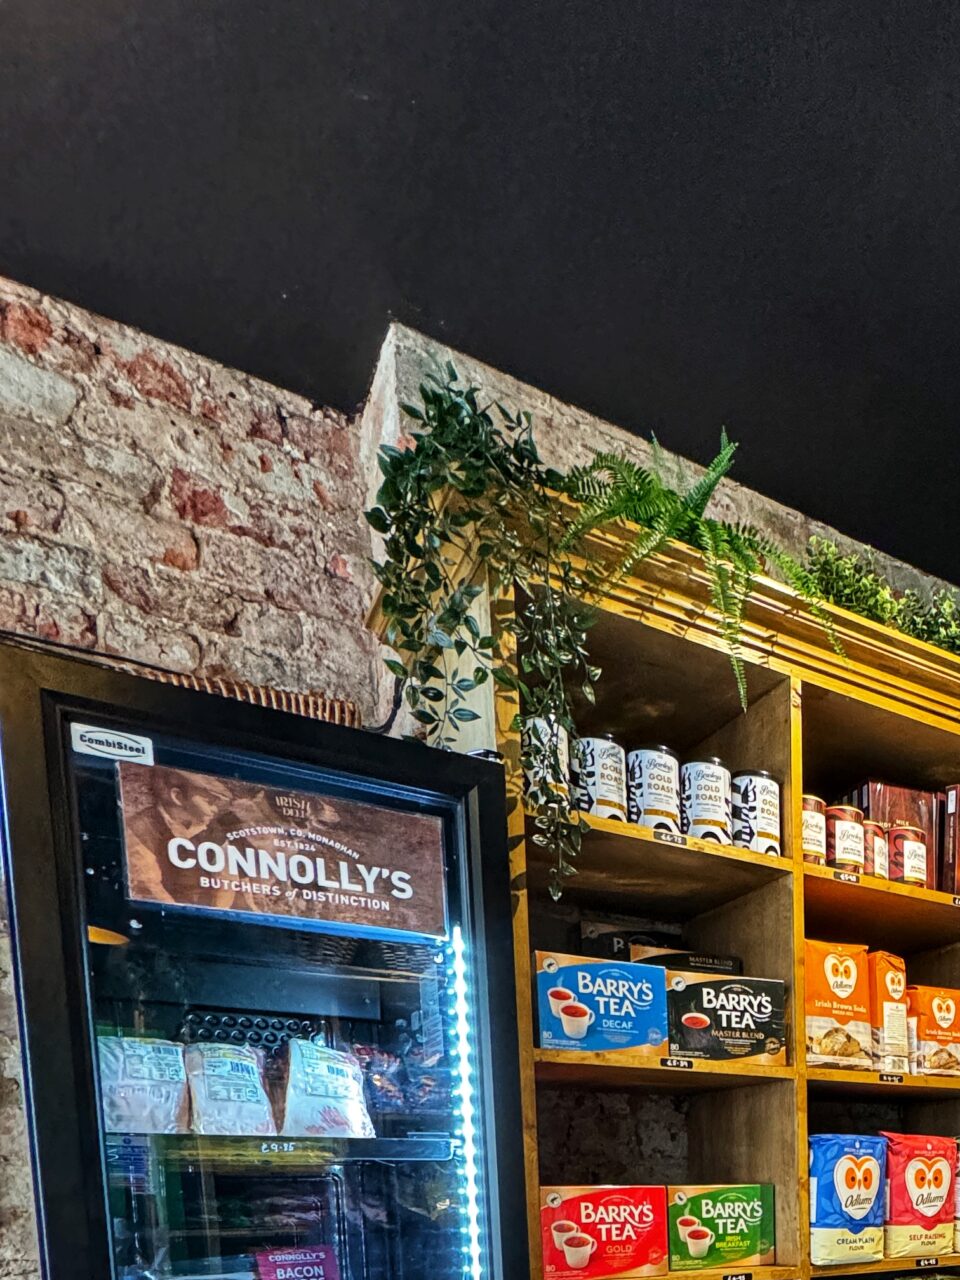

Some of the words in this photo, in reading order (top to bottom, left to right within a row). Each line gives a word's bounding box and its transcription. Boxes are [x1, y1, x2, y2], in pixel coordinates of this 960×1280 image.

[79, 733, 146, 755] CombiSteel
[648, 773, 672, 784] GOLD
[647, 782, 674, 794] ROAST
[696, 784, 720, 794] GOLD
[695, 793, 722, 804] ROAST
[226, 826, 288, 842] SCOTSTOWN,
[290, 829, 306, 839] CO.
[307, 833, 360, 860] MONAGHAN
[167, 836, 414, 900] CONNOLLY'S
[200, 876, 281, 897] BUTCHERS
[285, 888, 298, 900] of
[302, 889, 391, 912] DISTINCTION
[577, 971, 654, 1002] BARRY'S
[594, 997, 637, 1018] TEA
[701, 987, 773, 1015] BARRY'S
[815, 1000, 832, 1010] Irish
[832, 1001, 853, 1012] Brown
[602, 1019, 633, 1030] DECAF
[717, 1011, 756, 1030] TEA
[542, 1031, 552, 1039] 80
[711, 1030, 741, 1039] MASTER
[741, 1030, 765, 1040] BLEND
[670, 1043, 680, 1051] 80
[844, 1195, 872, 1209] Odlums
[915, 1192, 944, 1206] Odlums
[580, 1201, 654, 1226] BARRY'S
[701, 1198, 763, 1220] BARRY'S
[597, 1223, 637, 1242] TEA
[715, 1218, 749, 1234] TEA
[836, 1238, 857, 1246] CREAM
[858, 1236, 875, 1245] PLAIN
[909, 1233, 923, 1241] SELF
[924, 1232, 946, 1241] RAISING
[920, 1239, 937, 1247] FLOUR
[606, 1244, 633, 1254] GOLD
[715, 1240, 751, 1249] BREAKFAST
[268, 1251, 326, 1262] CONNOLLY'S
[276, 1265, 325, 1279] BACON
